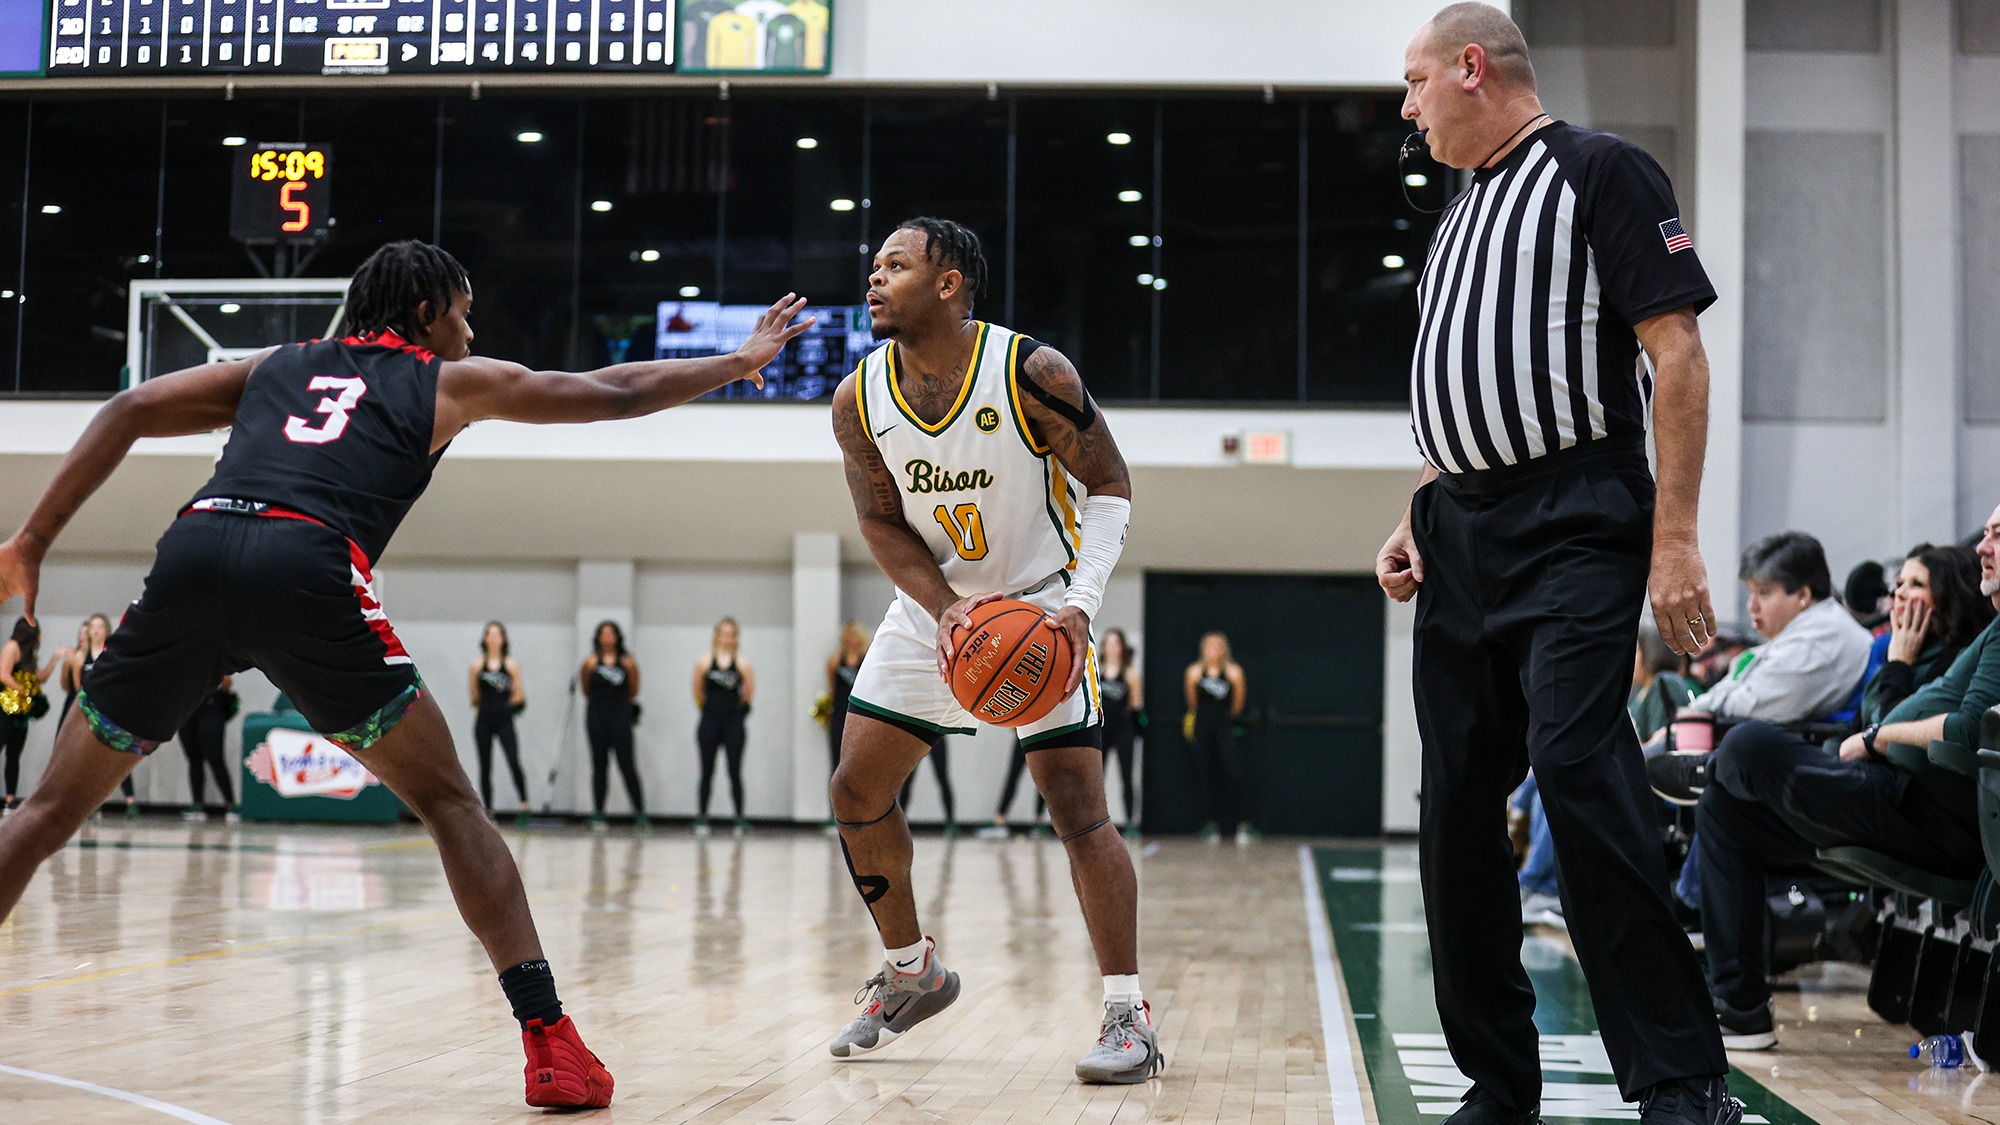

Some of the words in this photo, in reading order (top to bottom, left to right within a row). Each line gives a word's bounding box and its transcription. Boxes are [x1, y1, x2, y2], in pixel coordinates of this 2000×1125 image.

[100, 17, 112, 35] 1
[139, 16, 151, 35] 1
[256, 15, 270, 34] 1
[523, 12, 538, 32] 1
[179, 45, 192, 63] 1
[481, 42, 499, 61] 4
[520, 42, 539, 61] 4
[250, 150, 325, 182] 15:09
[279, 180, 311, 232] 5
[281, 374, 367, 444] 3
[980, 412, 996, 427] AE
[904, 458, 994, 494] Bison
[932, 502, 990, 562] 10
[1012, 641, 1049, 686] THE
[979, 678, 1031, 719] ROCK
[538, 1072, 553, 1084] 23
